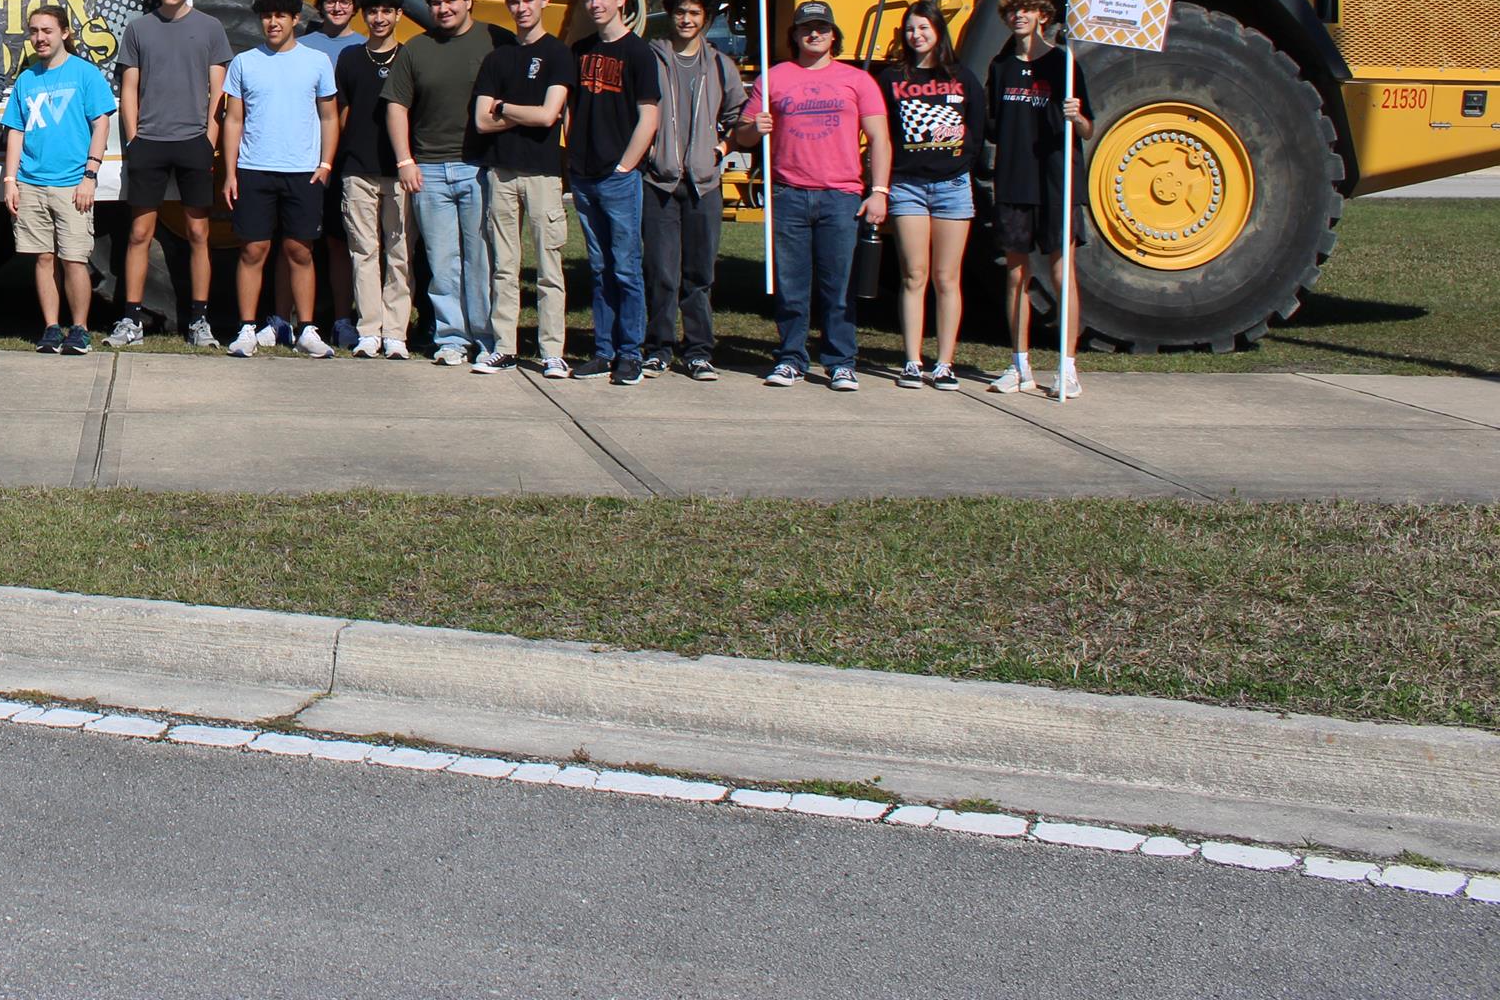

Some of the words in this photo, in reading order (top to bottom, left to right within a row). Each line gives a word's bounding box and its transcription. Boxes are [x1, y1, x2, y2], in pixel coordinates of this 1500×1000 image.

[1103, 7, 1123, 15] Group
[891, 78, 964, 100] Kodak
[1381, 88, 1427, 109] 21530
[779, 96, 845, 115] Baltimore
